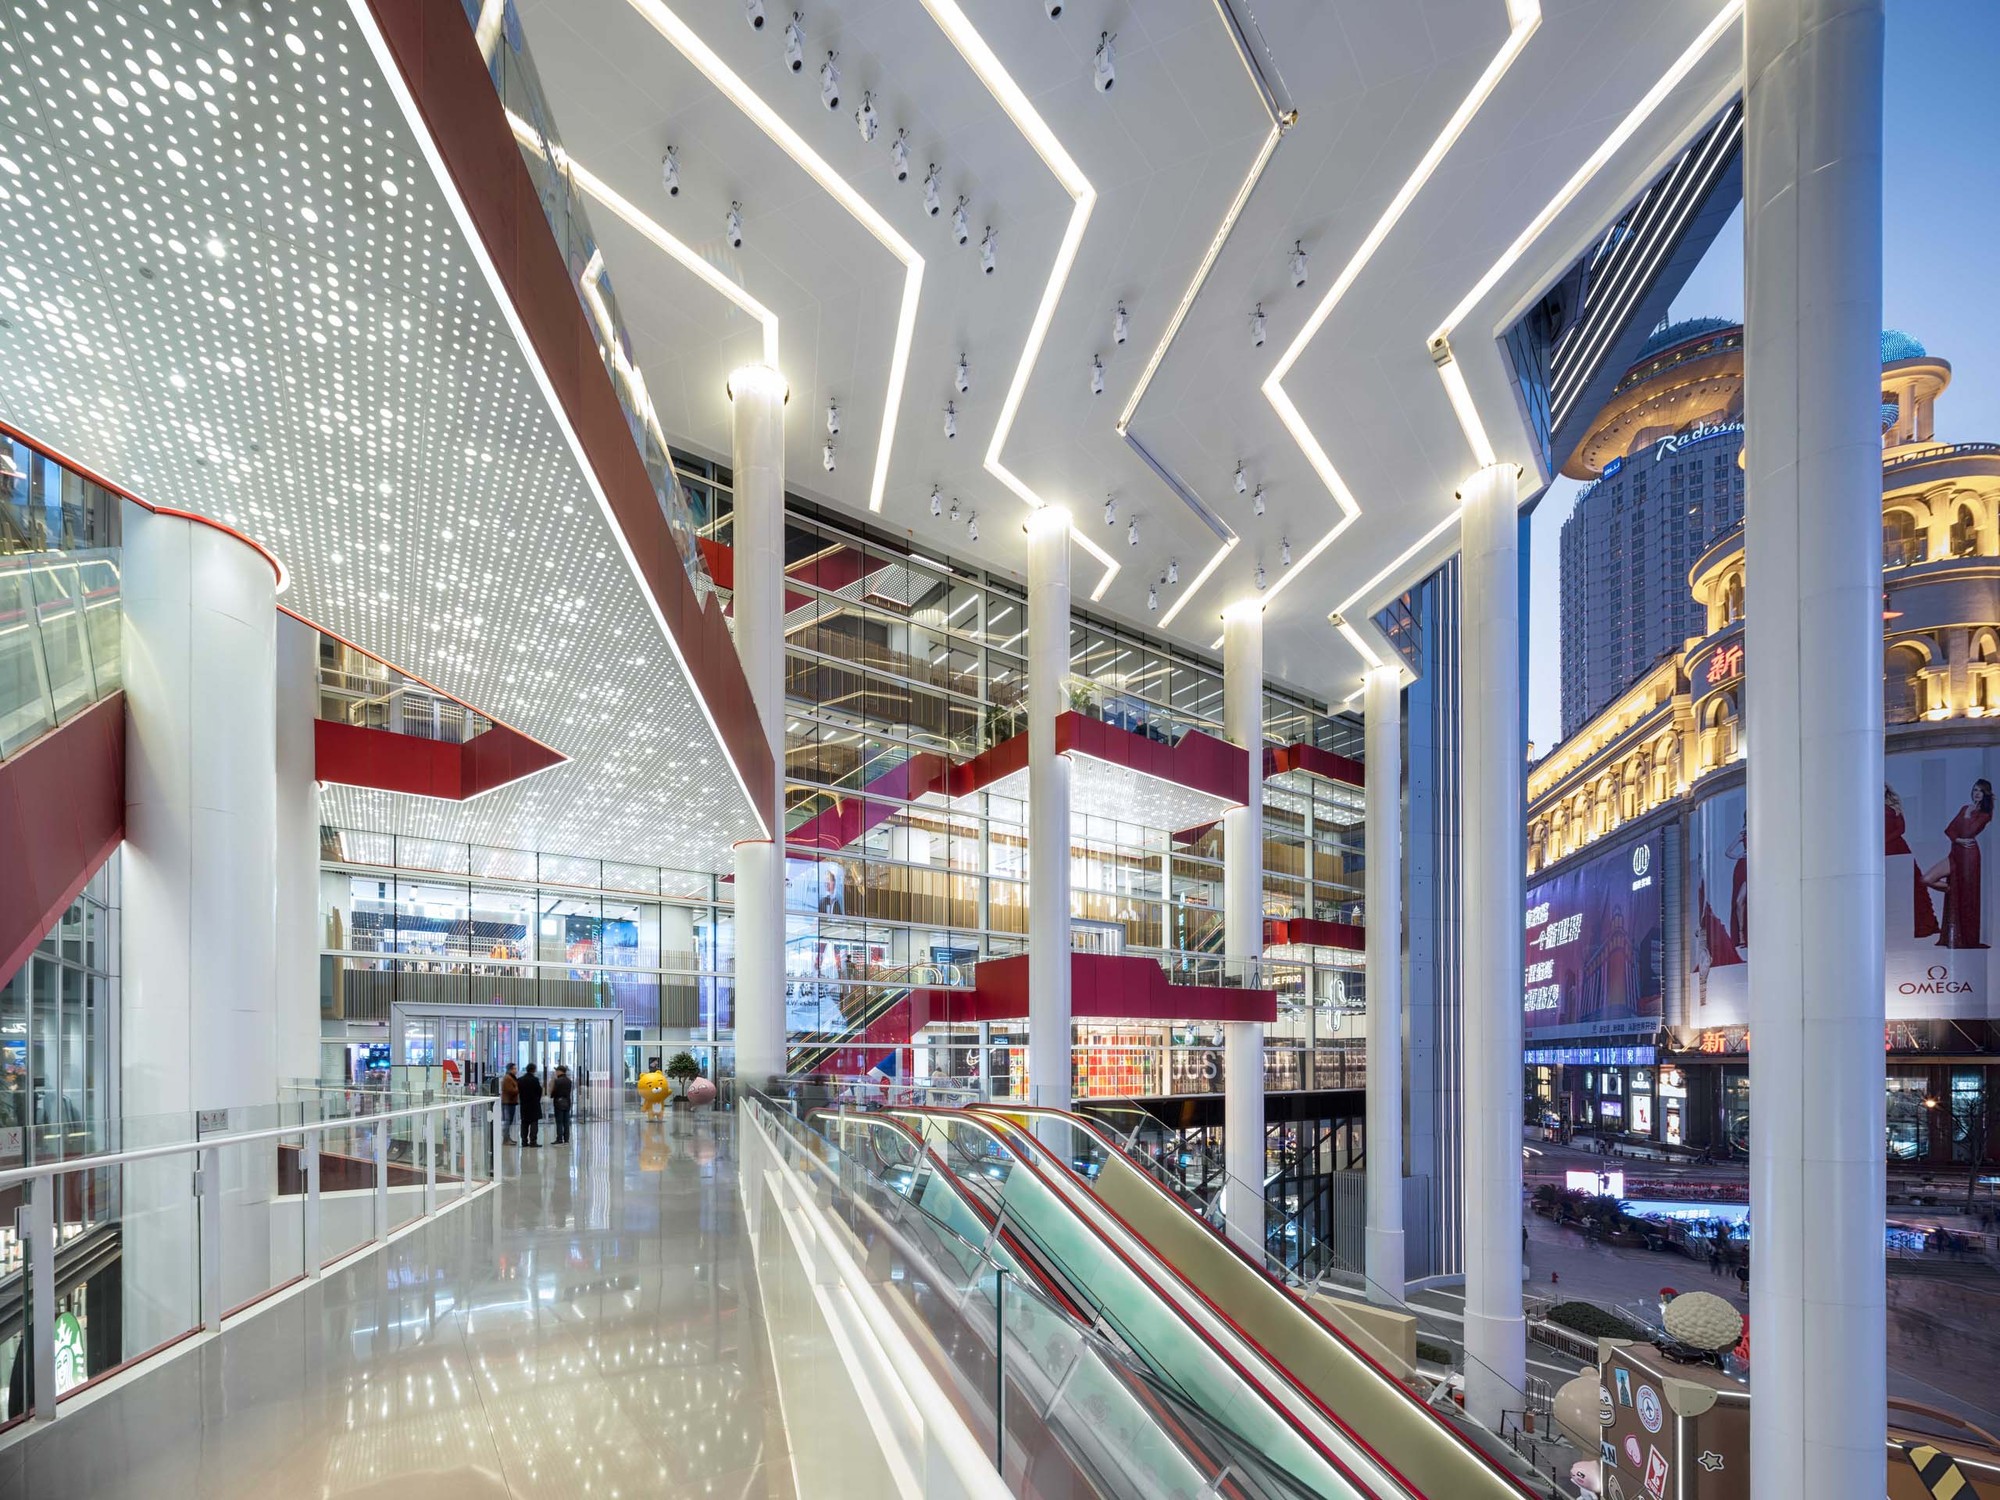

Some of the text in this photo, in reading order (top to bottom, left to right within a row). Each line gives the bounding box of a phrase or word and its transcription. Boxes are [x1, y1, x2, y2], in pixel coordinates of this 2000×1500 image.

[1656, 421, 1745, 461] Radisson
[1604, 462, 1620, 476] BLU
[1706, 645, 1744, 682] 新
[1281, 974, 1302, 985] FROG
[1899, 981, 1973, 995] OMEGA
[1172, 1050, 1225, 1080] JUS
